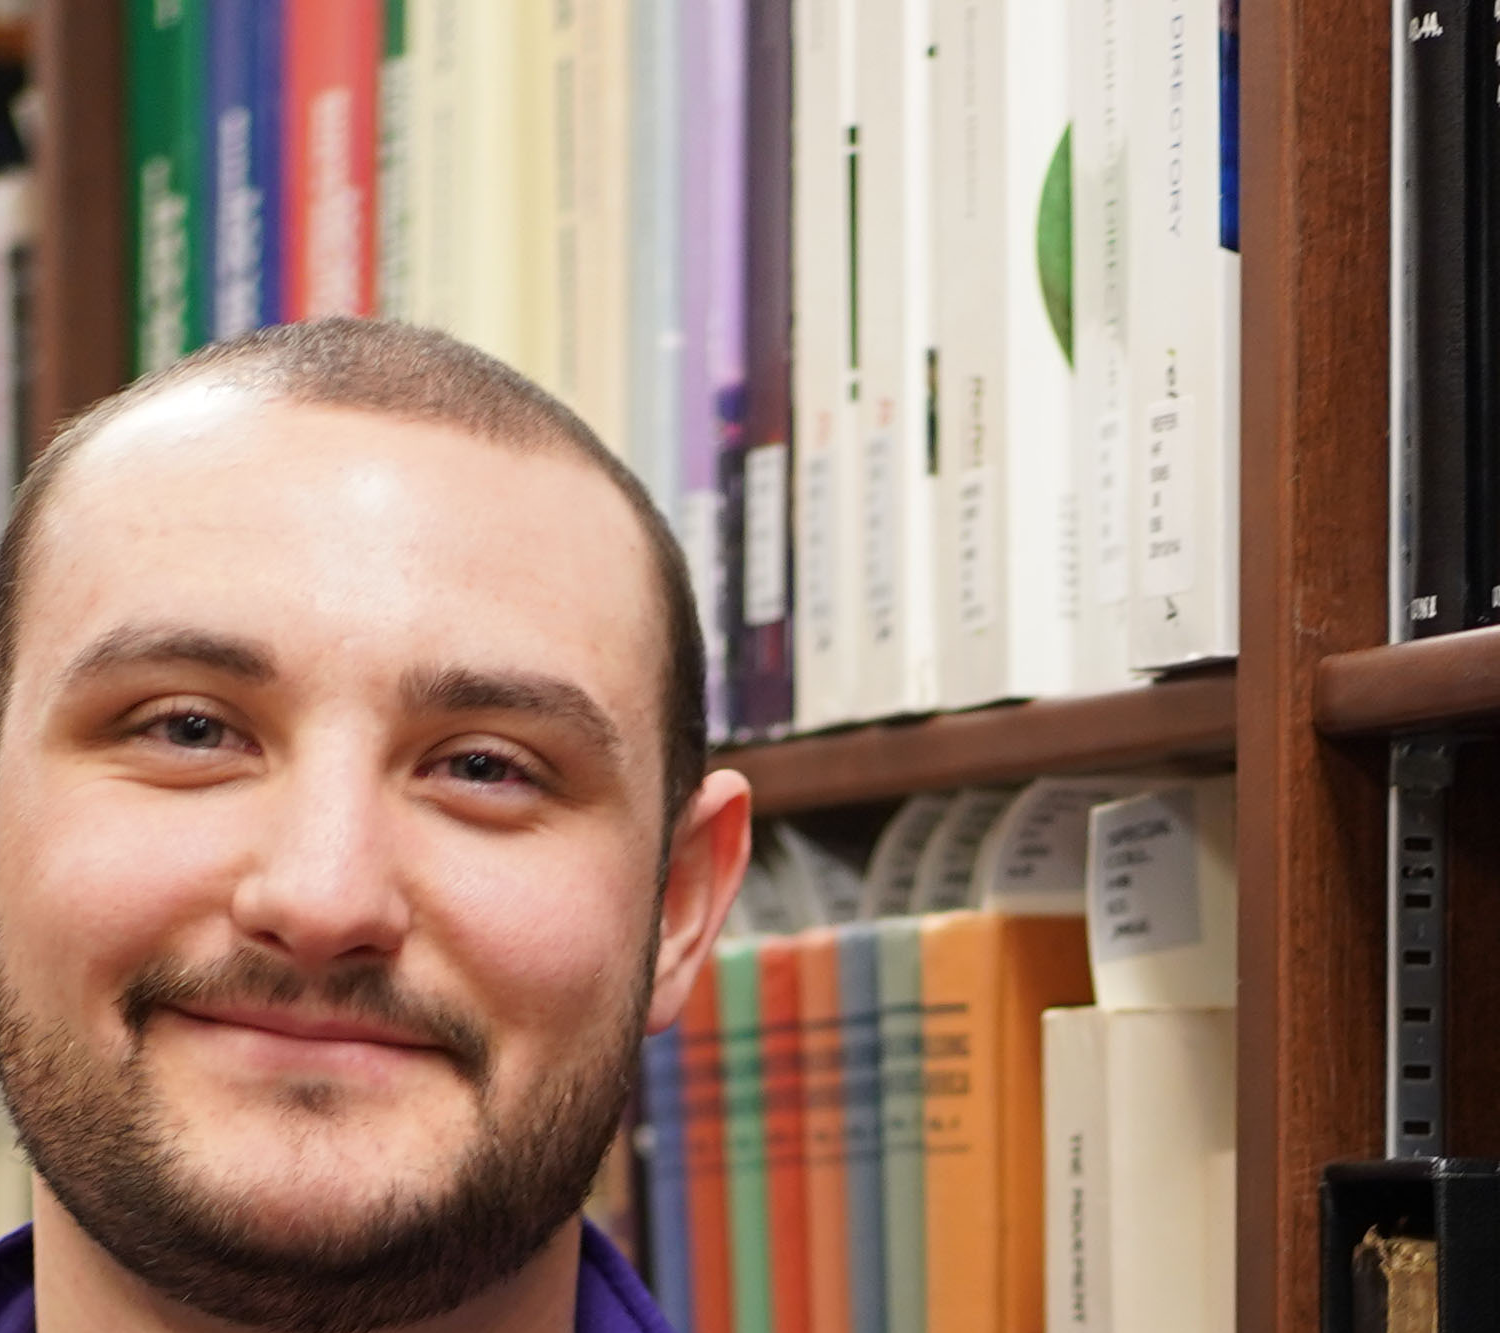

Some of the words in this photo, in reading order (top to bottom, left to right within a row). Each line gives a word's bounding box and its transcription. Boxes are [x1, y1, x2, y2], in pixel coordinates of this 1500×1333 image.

[1169, 15, 1186, 238] DIRECTORY
[1068, 1133, 1084, 1177] THE
[1070, 1187, 1087, 1323] MOVEMENT
